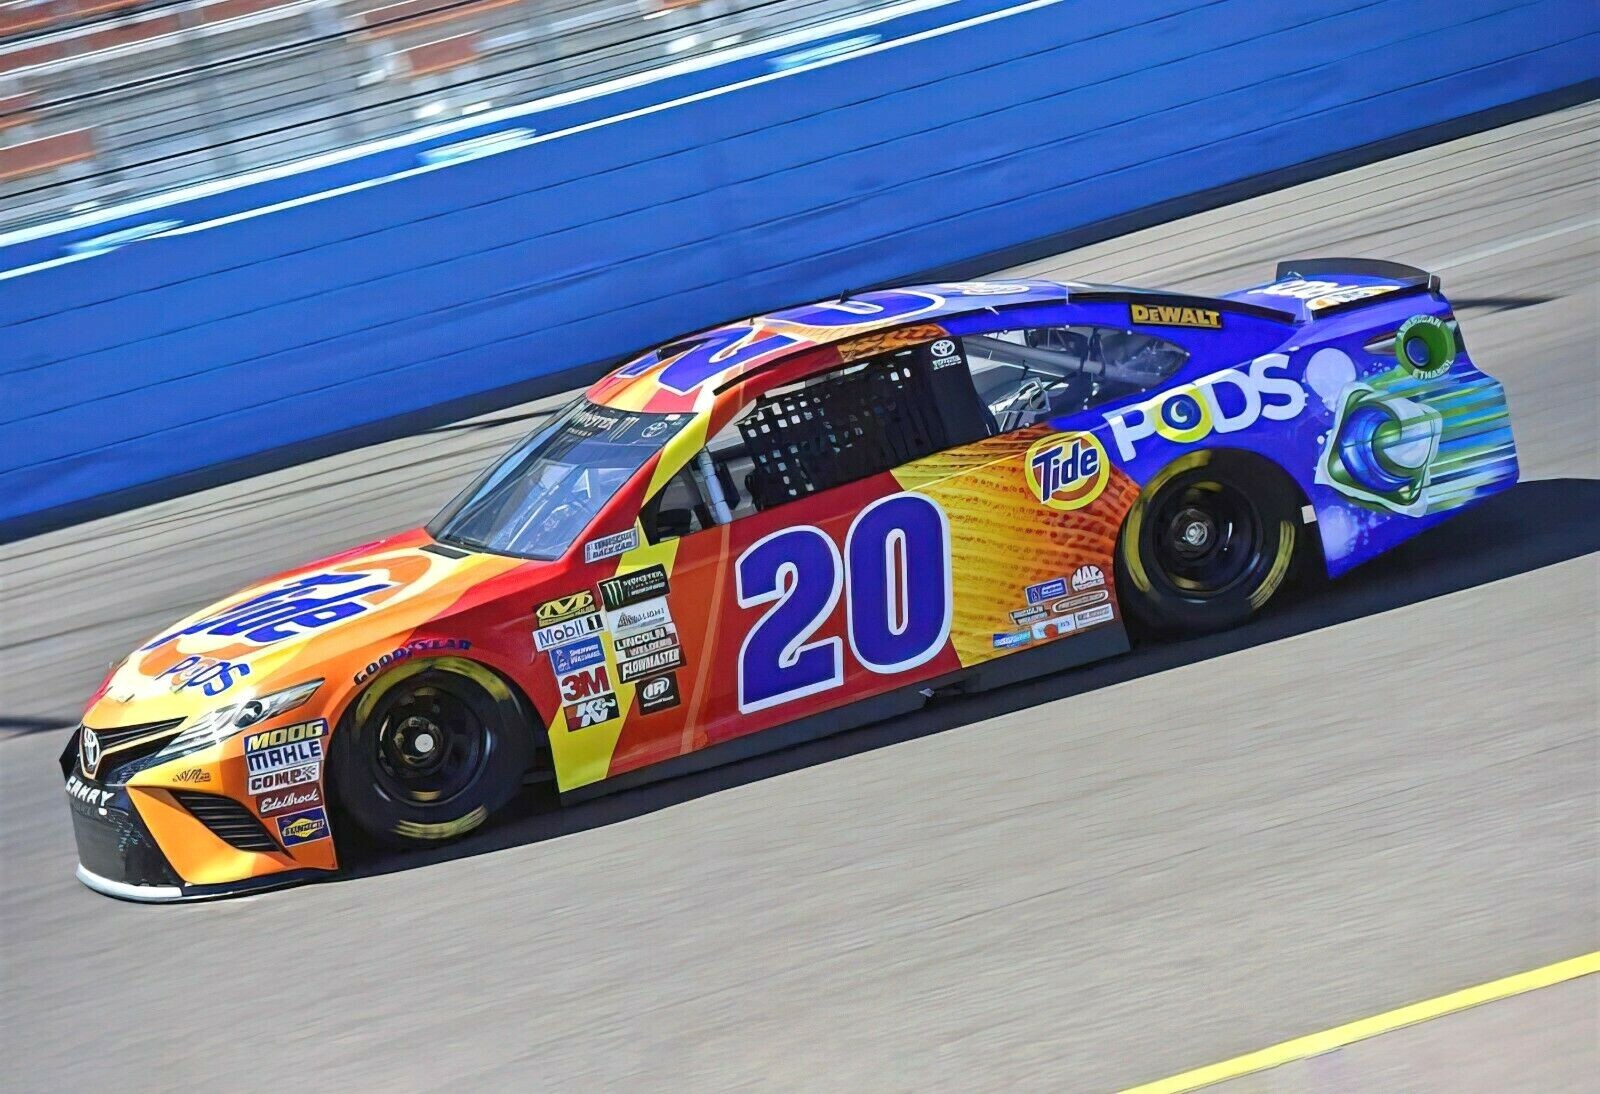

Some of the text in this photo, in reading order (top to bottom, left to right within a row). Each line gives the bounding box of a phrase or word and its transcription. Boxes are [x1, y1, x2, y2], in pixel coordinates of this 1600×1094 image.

[1102, 353, 1306, 462] PODS
[1031, 439, 1099, 504] Tide
[735, 491, 953, 715] 20
[538, 619, 584, 646] Mobil
[616, 628, 666, 650] LINCOLN
[622, 648, 680, 681] FLOWMASTER
[562, 666, 610, 701] 3M
[248, 719, 325, 751] MOOG
[250, 741, 322, 771] MAHLE
[260, 788, 319, 813] Edelbrock
[283, 819, 325, 836] SUNOCO
